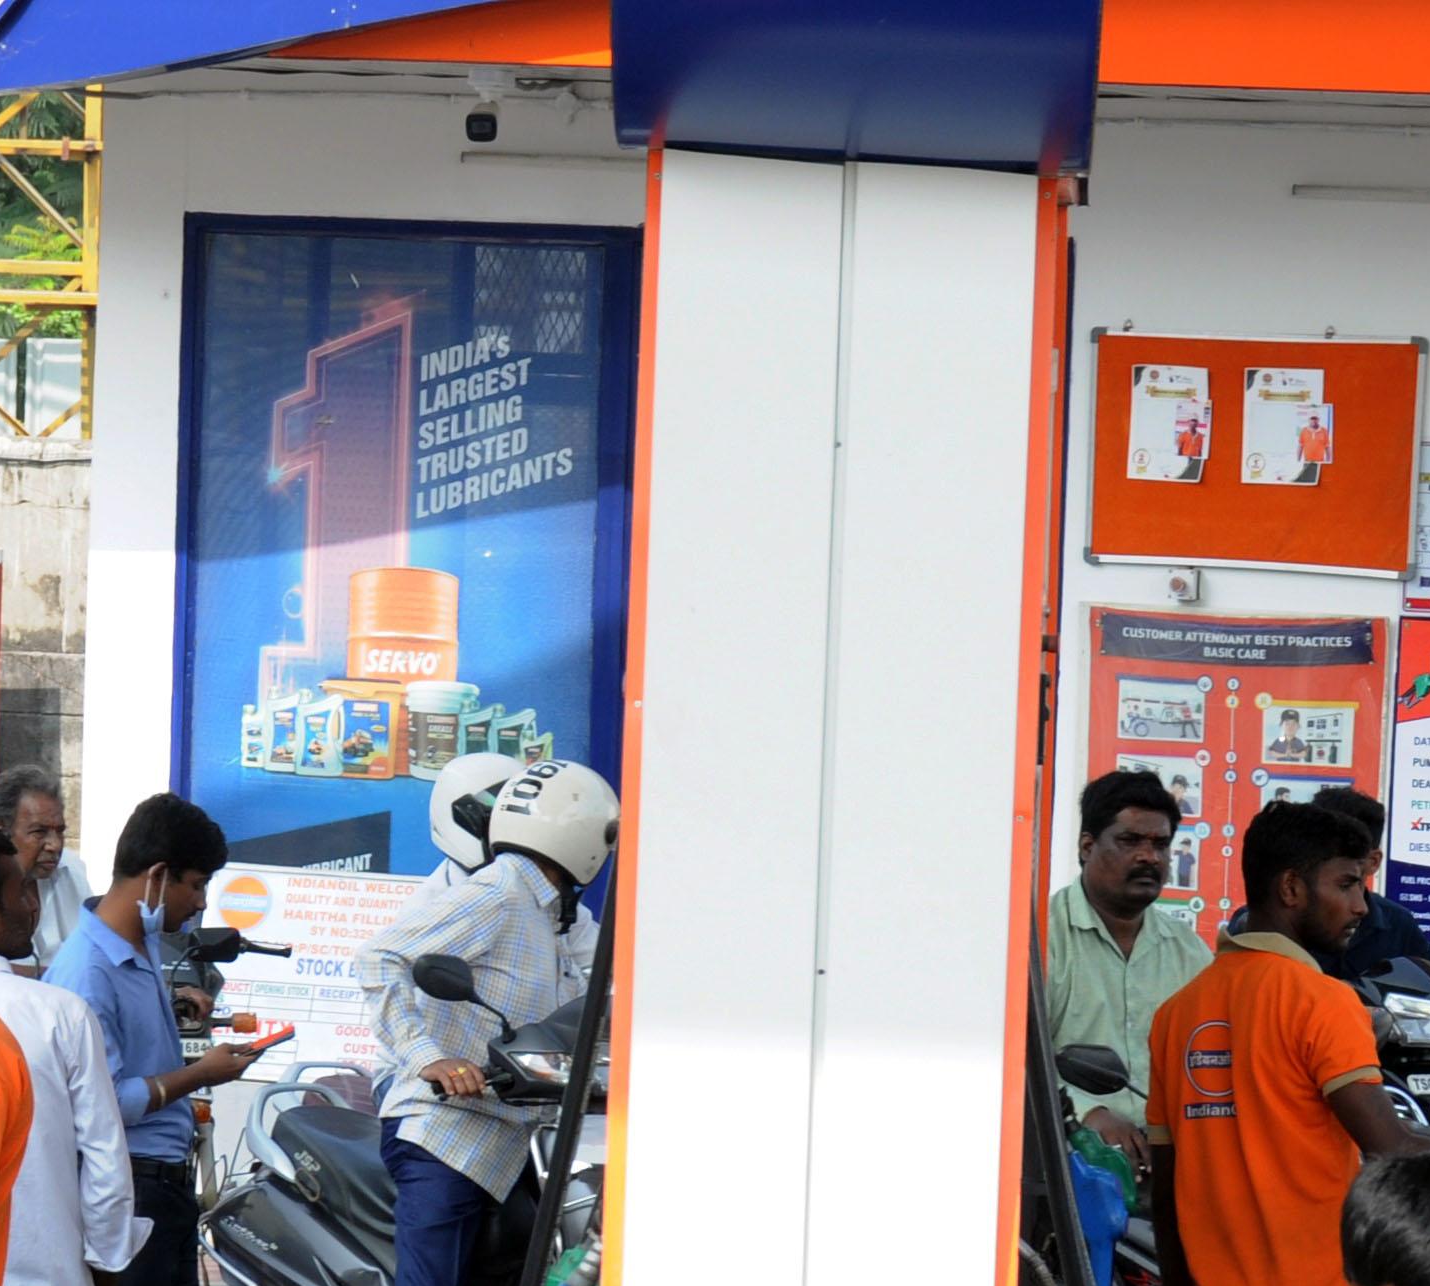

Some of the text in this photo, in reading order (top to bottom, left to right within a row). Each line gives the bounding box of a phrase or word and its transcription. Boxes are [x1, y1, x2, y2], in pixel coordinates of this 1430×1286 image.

[419, 357, 532, 417] LARGEST
[419, 395, 522, 450] SELLING
[417, 428, 528, 483] TRUSTED
[416, 448, 573, 519] LUBRICANTS
[1123, 627, 1353, 648] CUSTOMER ATTENDANT BEST PRACTICES
[365, 648, 440, 675] SERVO
[1203, 646, 1267, 660] BASIC CARE
[302, 853, 372, 873] UBRICANT
[287, 877, 415, 896] INDIANOIL WELCO
[286, 893, 355, 907] QUALITY AND
[283, 910, 396, 926] HARITHA FILLIN
[296, 958, 342, 977] STOCK
[336, 1026, 370, 1037] GOOD
[1186, 1104, 1237, 1118] Indian
